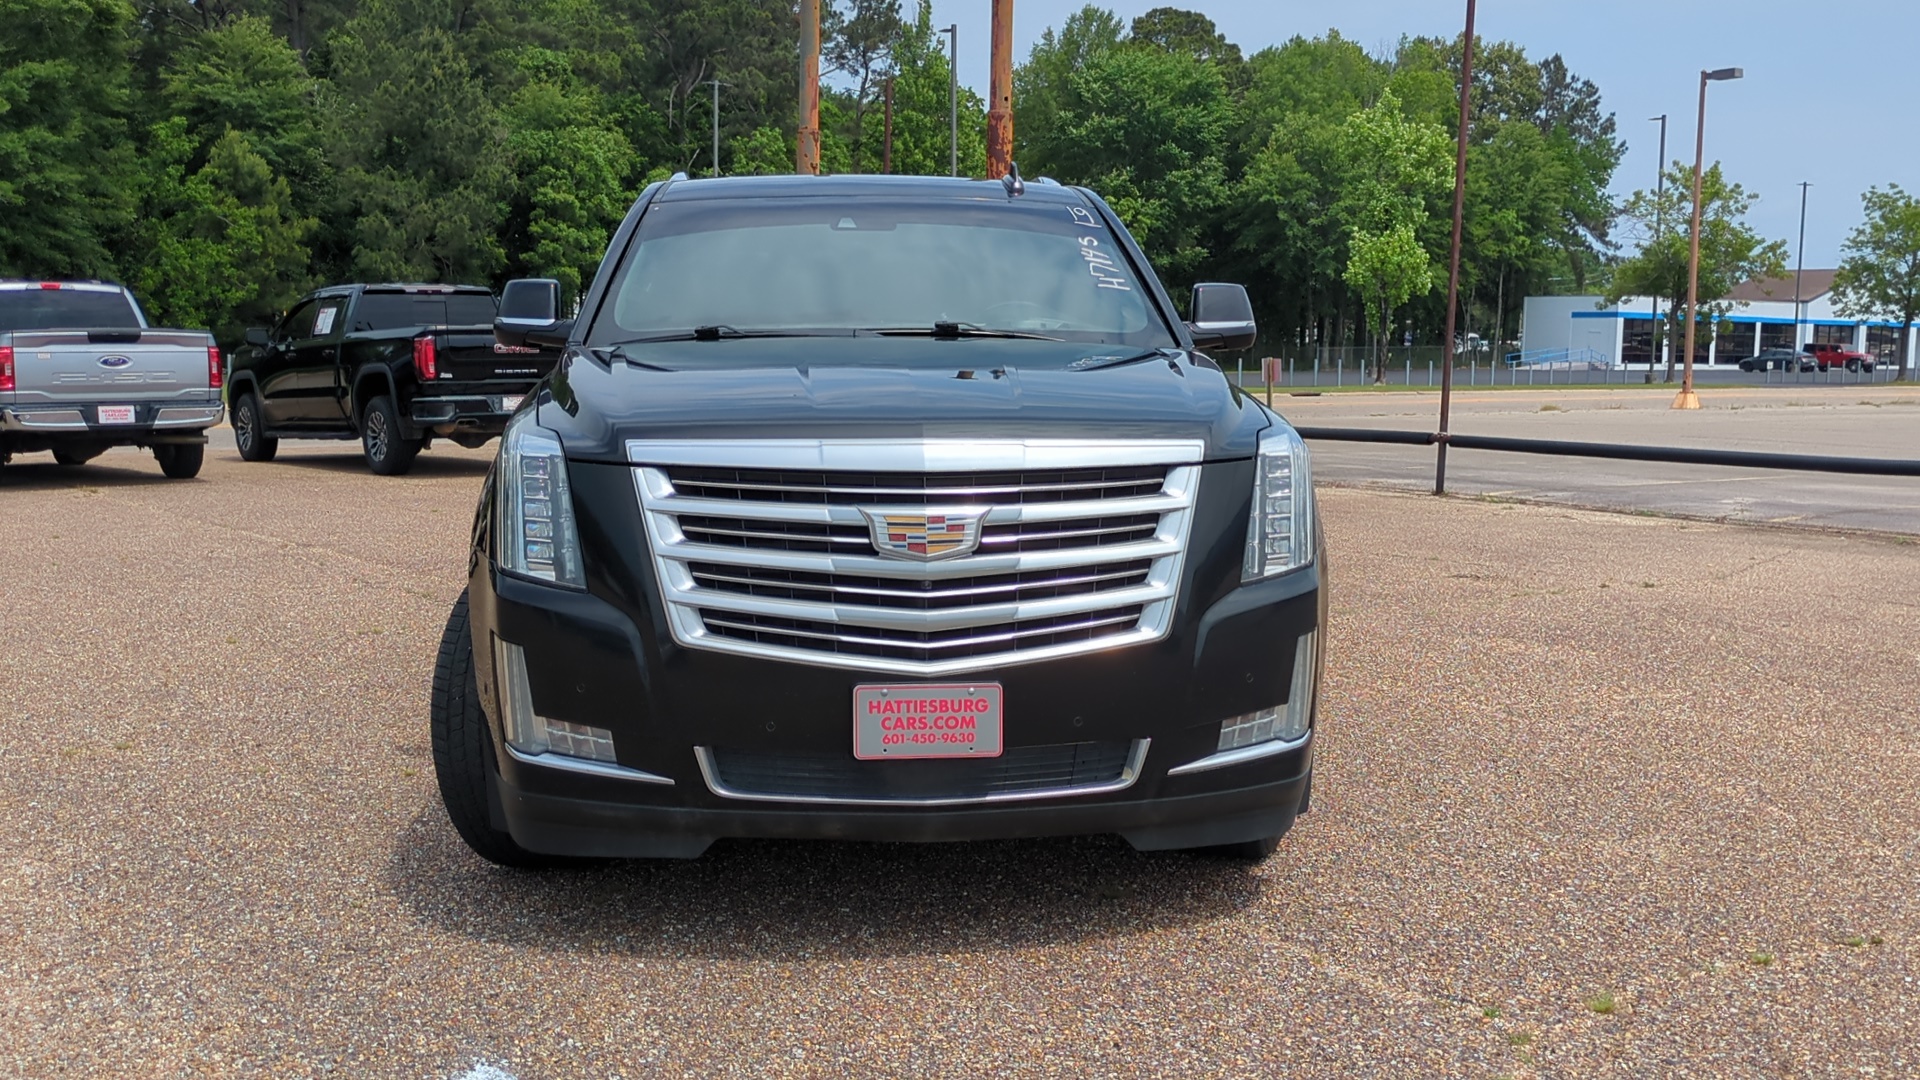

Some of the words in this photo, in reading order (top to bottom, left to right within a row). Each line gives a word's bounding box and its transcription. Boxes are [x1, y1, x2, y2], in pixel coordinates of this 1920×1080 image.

[1078, 236, 1131, 290] H7145
[868, 699, 989, 714] HATTIESBURG
[880, 716, 976, 730] CARS.COM
[882, 733, 975, 744] 601-450-9630
